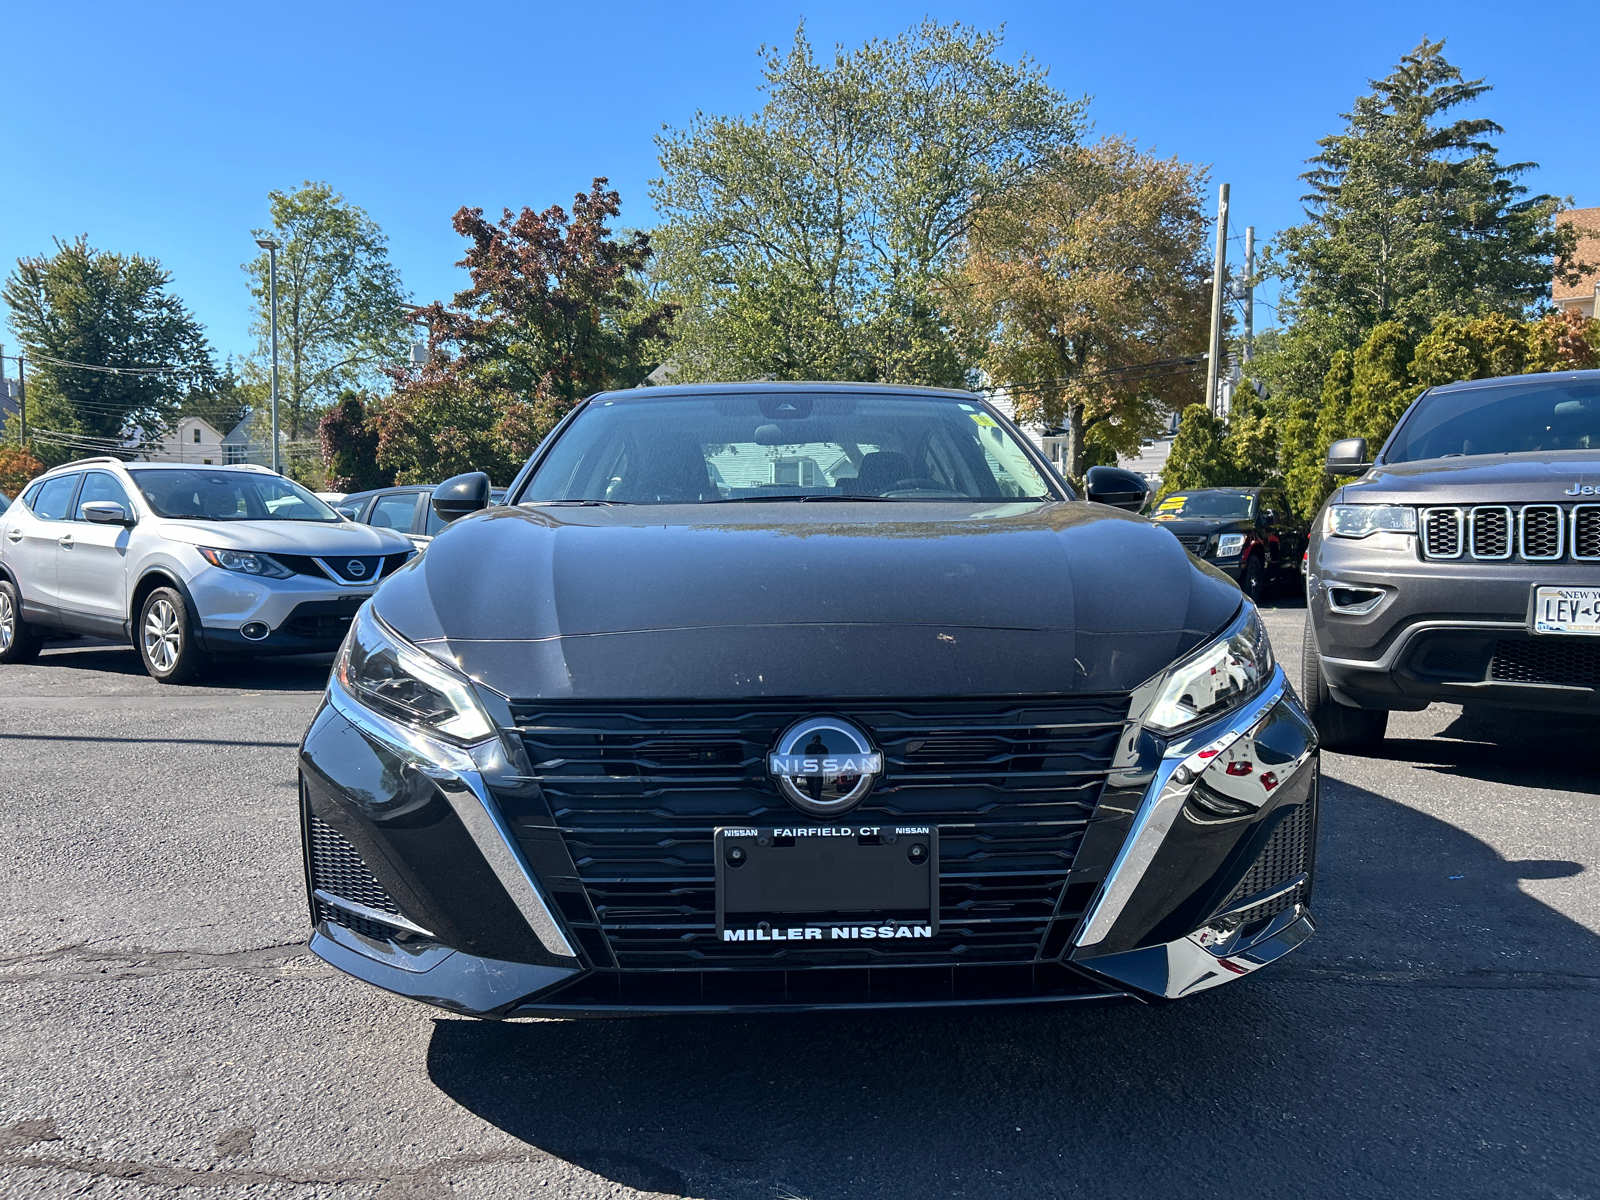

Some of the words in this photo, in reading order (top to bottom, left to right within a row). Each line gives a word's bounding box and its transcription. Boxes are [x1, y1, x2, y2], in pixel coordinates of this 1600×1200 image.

[1565, 591, 1590, 599] NEW
[773, 757, 880, 773] NISSAN
[724, 829, 758, 837] NISSAN
[773, 828, 855, 838] FAIRFIELD,
[859, 827, 880, 836] CT
[723, 929, 822, 942] MILLER
[831, 926, 932, 939] NISSAN
